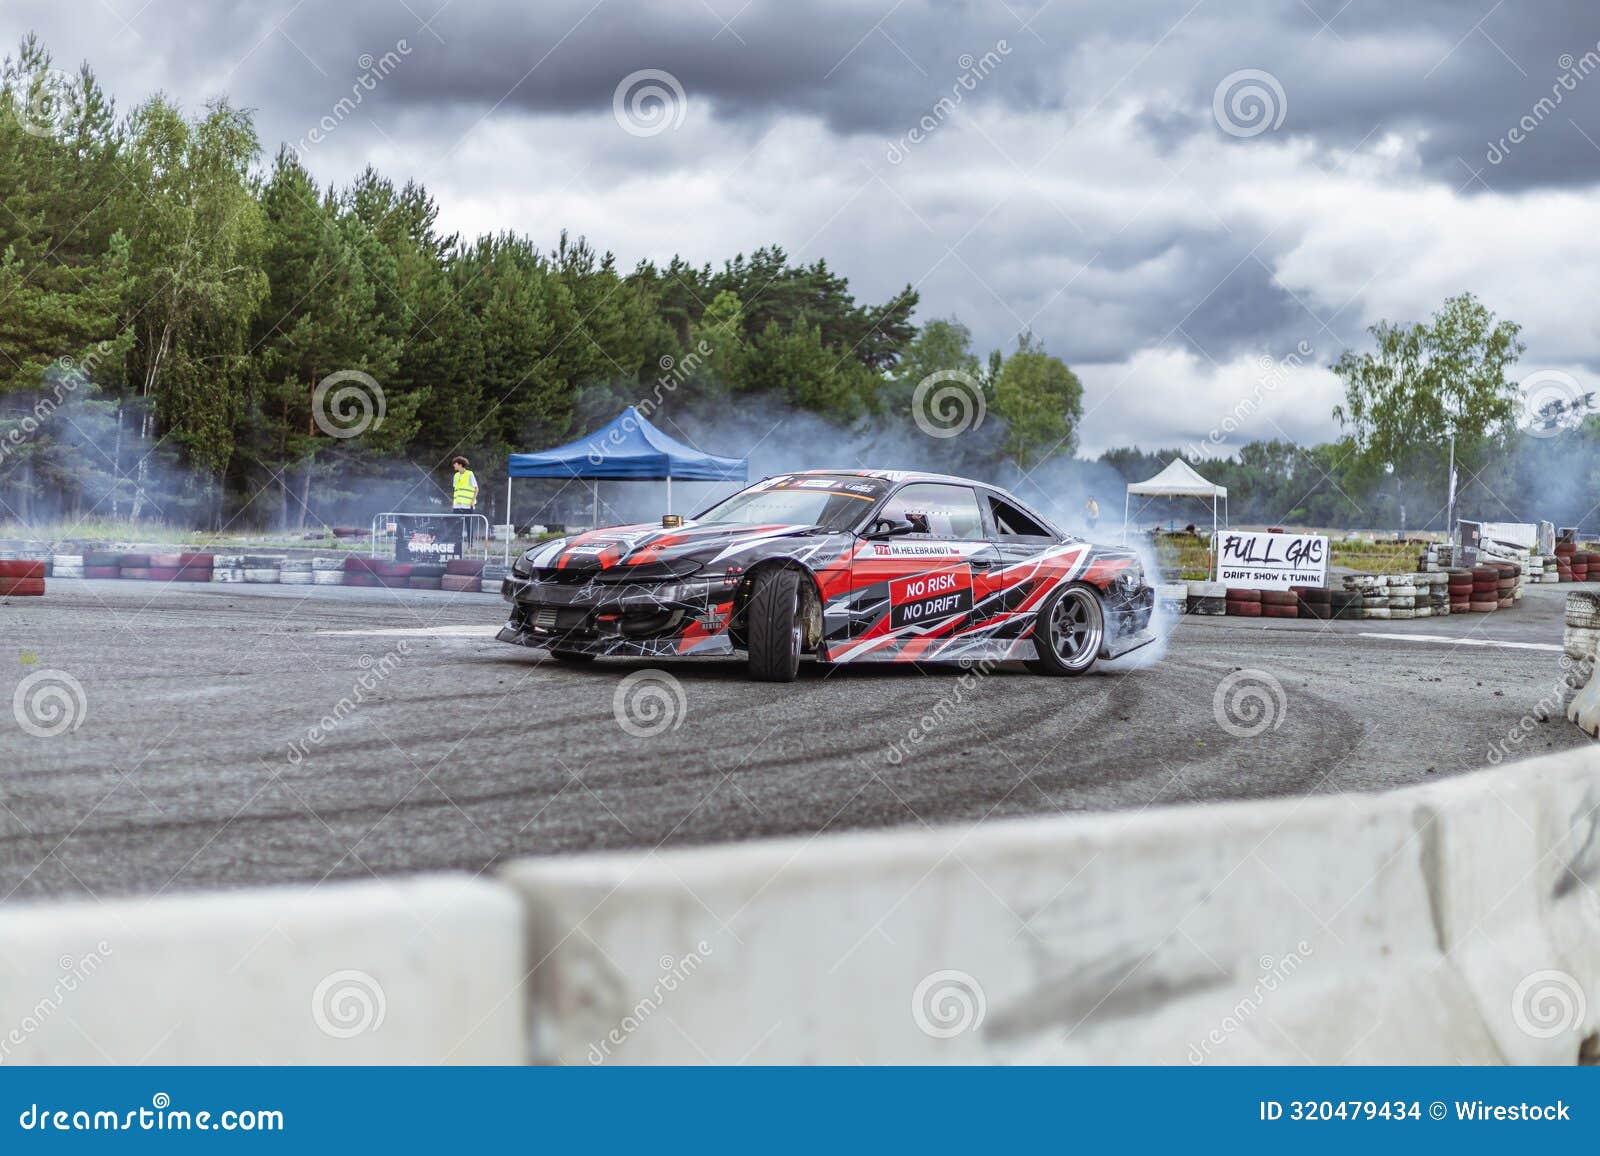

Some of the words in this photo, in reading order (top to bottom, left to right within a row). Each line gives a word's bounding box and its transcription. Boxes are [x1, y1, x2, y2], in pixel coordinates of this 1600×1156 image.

[1223, 535, 1283, 565] FULL
[1285, 539, 1323, 570] GAS
[905, 581, 925, 598] NO
[927, 573, 956, 593] RISK
[1223, 571, 1252, 580] DRIFT
[1253, 572, 1280, 581] SHOW
[903, 604, 922, 621] NO
[924, 594, 961, 616] DRIFT
